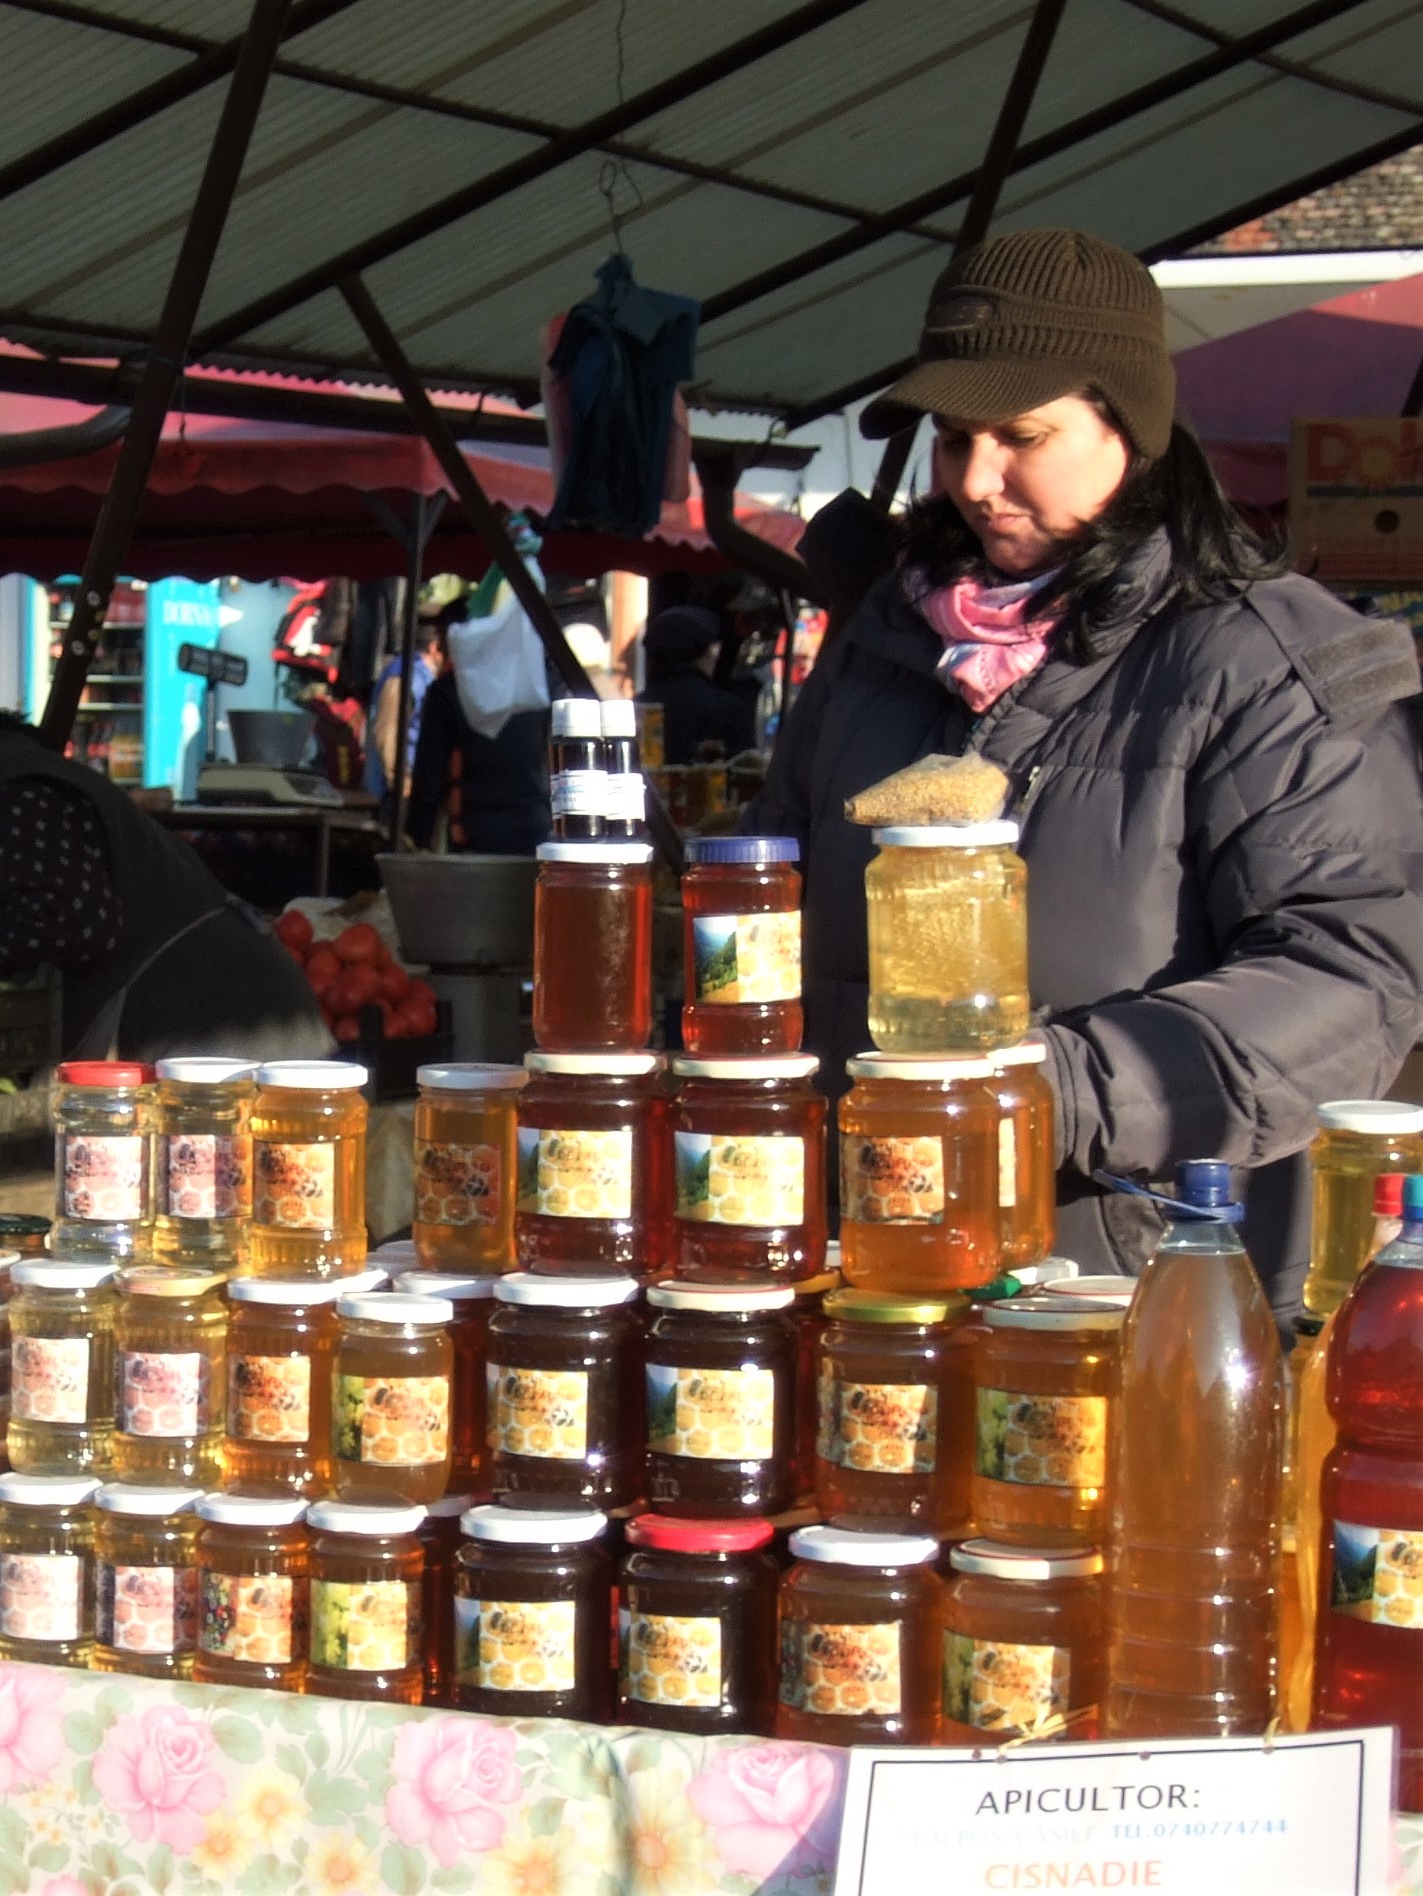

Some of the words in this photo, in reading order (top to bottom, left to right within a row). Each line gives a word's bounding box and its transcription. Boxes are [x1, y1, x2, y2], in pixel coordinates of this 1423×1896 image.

[975, 1784, 1200, 1816] APICULTOR:
[1112, 1819, 1288, 1839] TEL.0740774744
[984, 1860, 1162, 1889] CISNADIE
